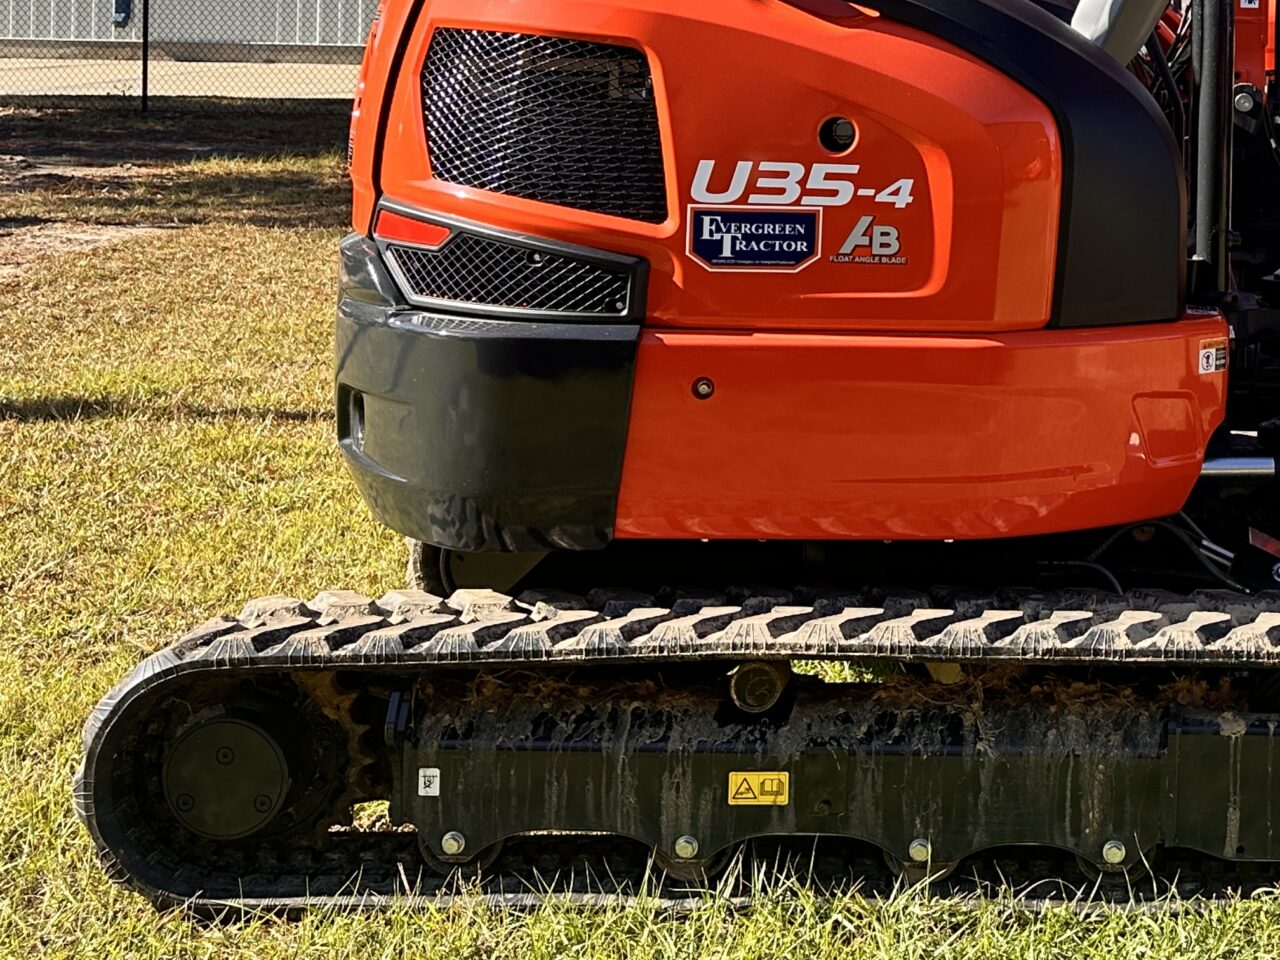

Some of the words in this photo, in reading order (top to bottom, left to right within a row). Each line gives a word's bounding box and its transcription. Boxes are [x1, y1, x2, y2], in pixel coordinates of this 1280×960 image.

[690, 159, 915, 208] U35-4
[700, 215, 805, 240] EVERGREEN
[718, 233, 808, 257] TRACTOR
[829, 255, 854, 263] FLOAT
[881, 256, 907, 264] BLADE
